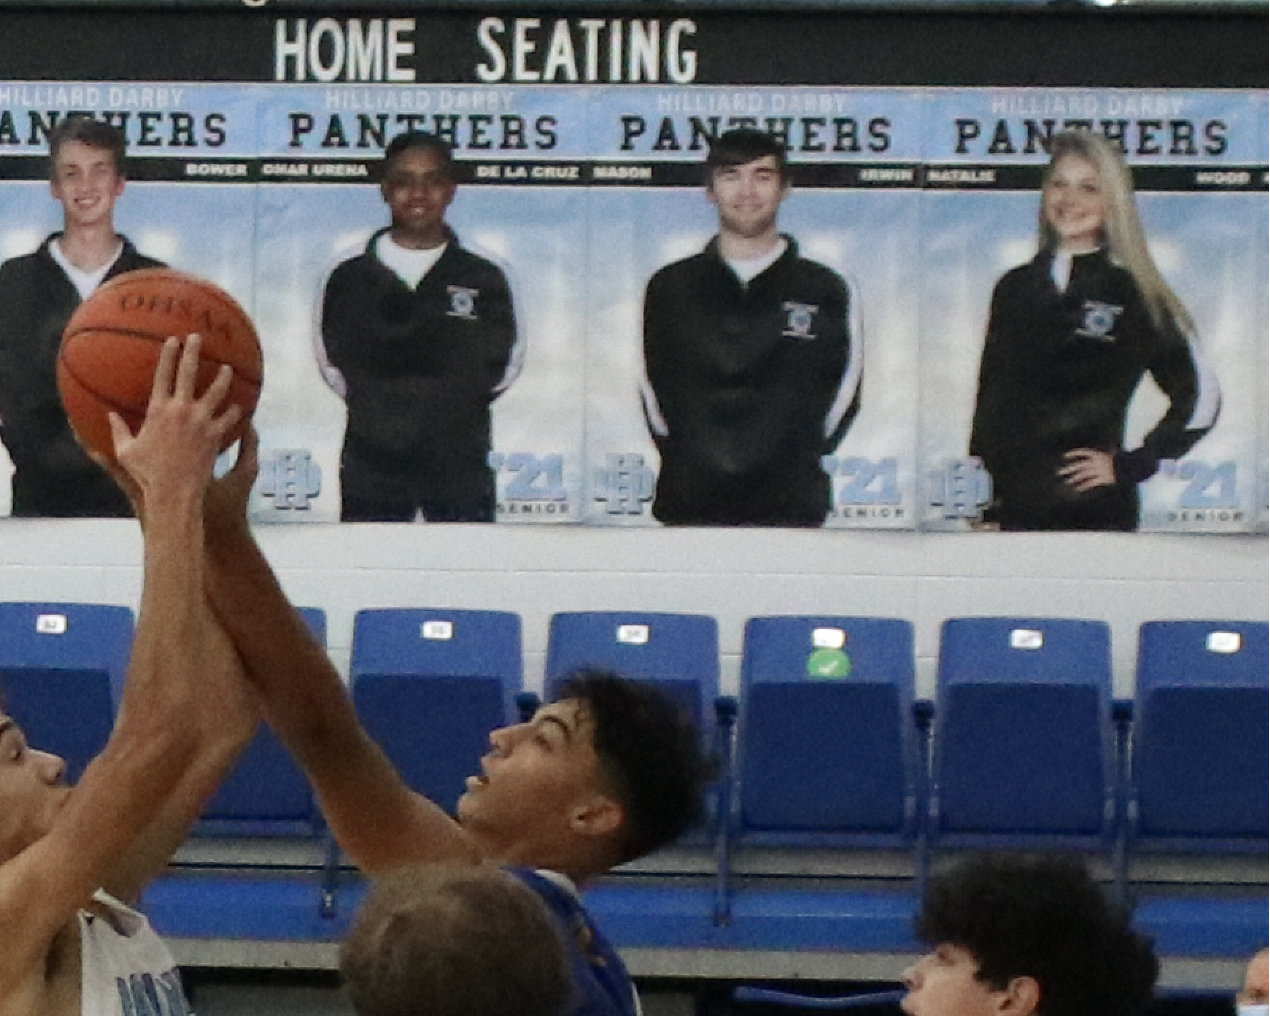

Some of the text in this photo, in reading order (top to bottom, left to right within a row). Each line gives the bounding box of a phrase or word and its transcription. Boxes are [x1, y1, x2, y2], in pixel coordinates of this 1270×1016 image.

[275, 18, 698, 83] HOME SEATING
[109, 87, 184, 108] DARBY
[477, 165, 500, 177] DE
[504, 166, 528, 178] LA
[531, 166, 579, 179] CRUZ
[496, 503, 569, 514] SENIOR
